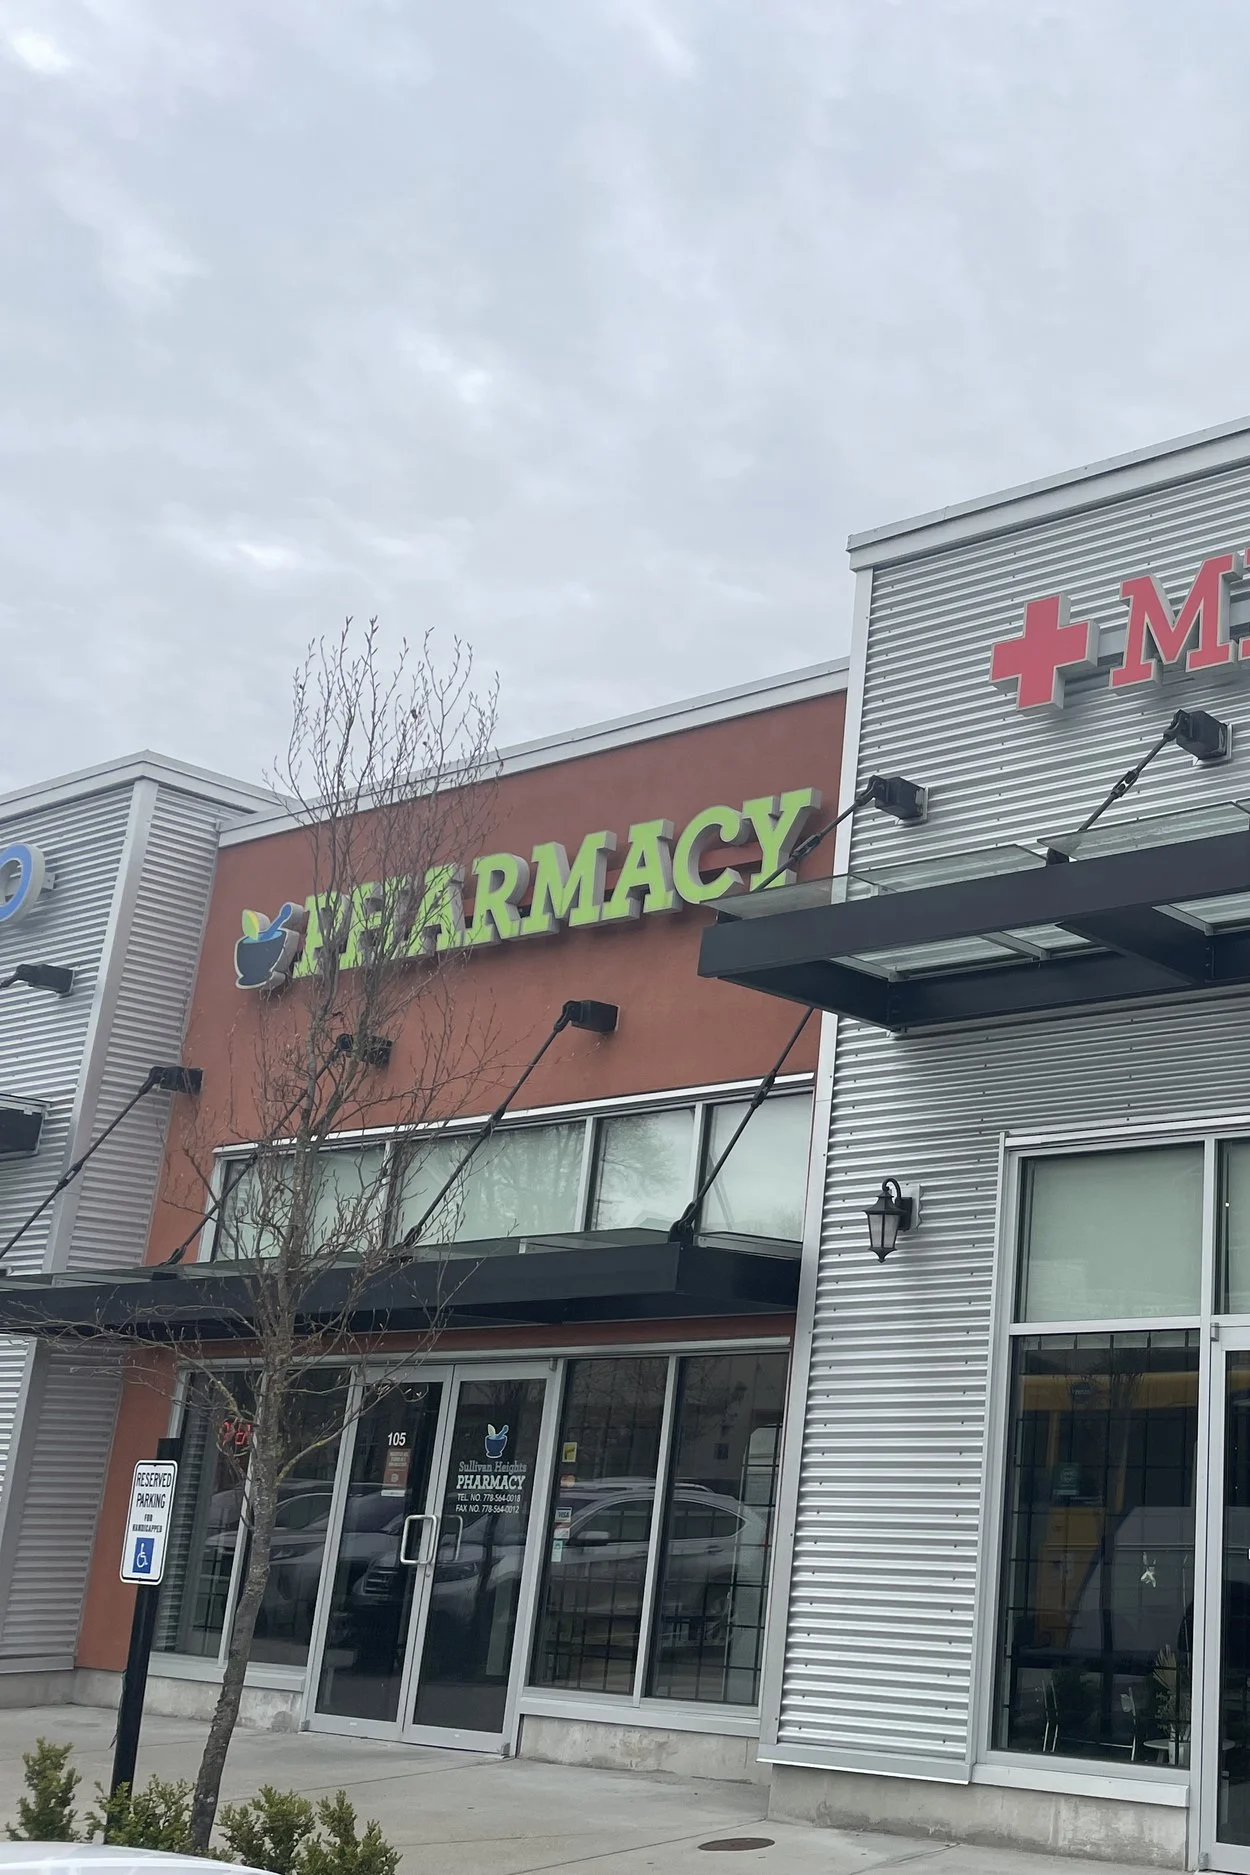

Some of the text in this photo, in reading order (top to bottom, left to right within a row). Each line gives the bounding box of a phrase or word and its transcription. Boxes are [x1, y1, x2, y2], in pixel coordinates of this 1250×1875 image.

[293, 787, 820, 978] PHARMACY
[388, 1432, 406, 1446] 105
[459, 1460, 527, 1475] Sullivan Heights
[136, 1472, 172, 1487] RESERVED
[456, 1474, 526, 1489] PHARMACY
[136, 1493, 166, 1508] PARKING
[483, 1494, 521, 1502] 778-564-0018
[482, 1504, 519, 1513] 778-564-0012
[132, 1524, 162, 1532] HANDICAPPED
